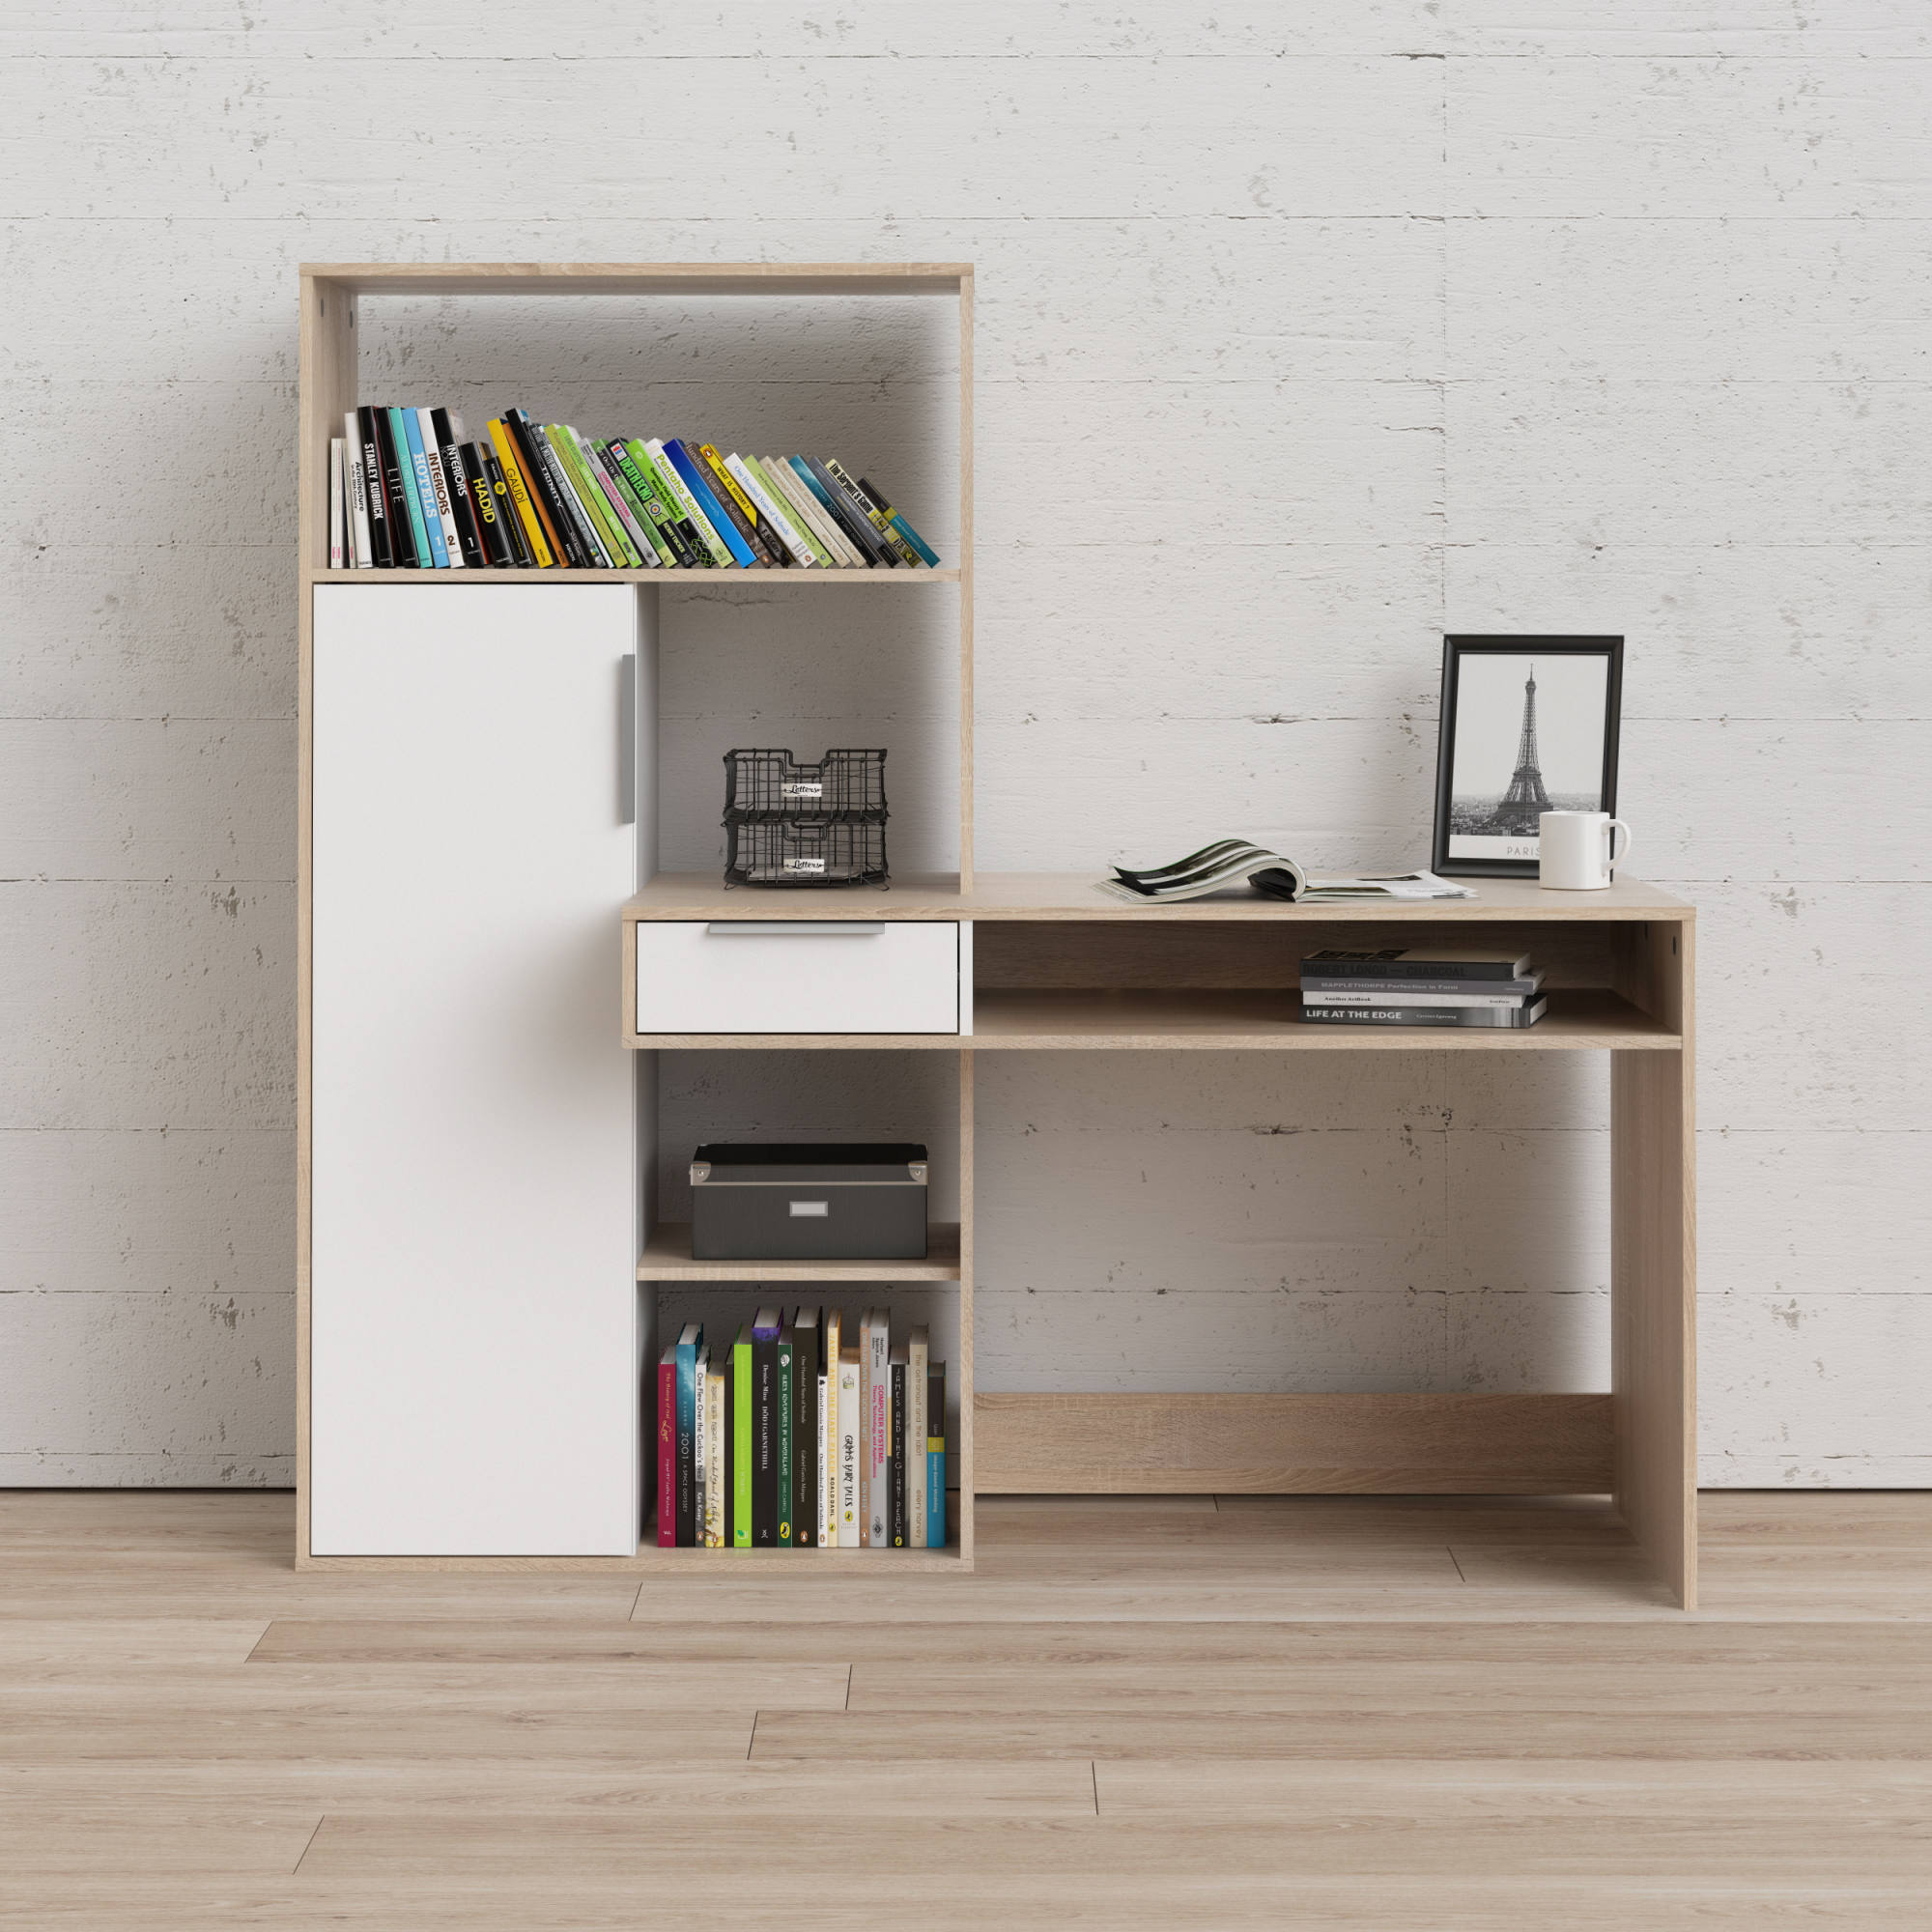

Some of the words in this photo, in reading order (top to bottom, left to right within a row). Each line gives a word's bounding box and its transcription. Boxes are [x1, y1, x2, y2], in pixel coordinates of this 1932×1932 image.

[364, 442, 378, 479] STANLEY
[446, 443, 466, 497] INTERIORS
[619, 457, 640, 482] DEATH
[634, 479, 652, 500] ECHO
[355, 461, 366, 511] Architecture
[369, 481, 384, 519] KUBRICK
[387, 467, 404, 502] LIFE
[413, 451, 437, 518] HOTELS
[428, 452, 449, 515] INTERIORS
[472, 478, 495, 523] HADID
[540, 466, 563, 508] TRINITY
[601, 471, 617, 496] COMPUTER
[650, 467, 664, 485] Quantum
[668, 497, 679, 510] Theory
[657, 454, 685, 494] Pentaho
[684, 496, 715, 540] Solutions
[705, 472, 722, 493] Years
[720, 493, 727, 501] of
[726, 502, 749, 532] Solitude
[717, 467, 727, 479] WHAT
[731, 487, 746, 504] HISTORY
[733, 466, 744, 476] One
[742, 476, 759, 497] Hundred
[757, 496, 770, 510] Years
[773, 516, 789, 535] Solitude
[830, 464, 841, 475] The
[838, 471, 862, 498] Serpent's
[858, 497, 873, 512] Game
[827, 502, 840, 519] 2001
[435, 535, 441, 546] 1
[447, 534, 454, 545] 2
[467, 536, 473, 548] 1
[786, 784, 818, 794] Letters
[1507, 846, 1540, 856] PARIS
[1306, 1009, 1329, 1018] LIFE
[1348, 1010, 1370, 1019] THE
[842, 1464, 853, 1482] FAIRY
[844, 1484, 853, 1506] TALES
